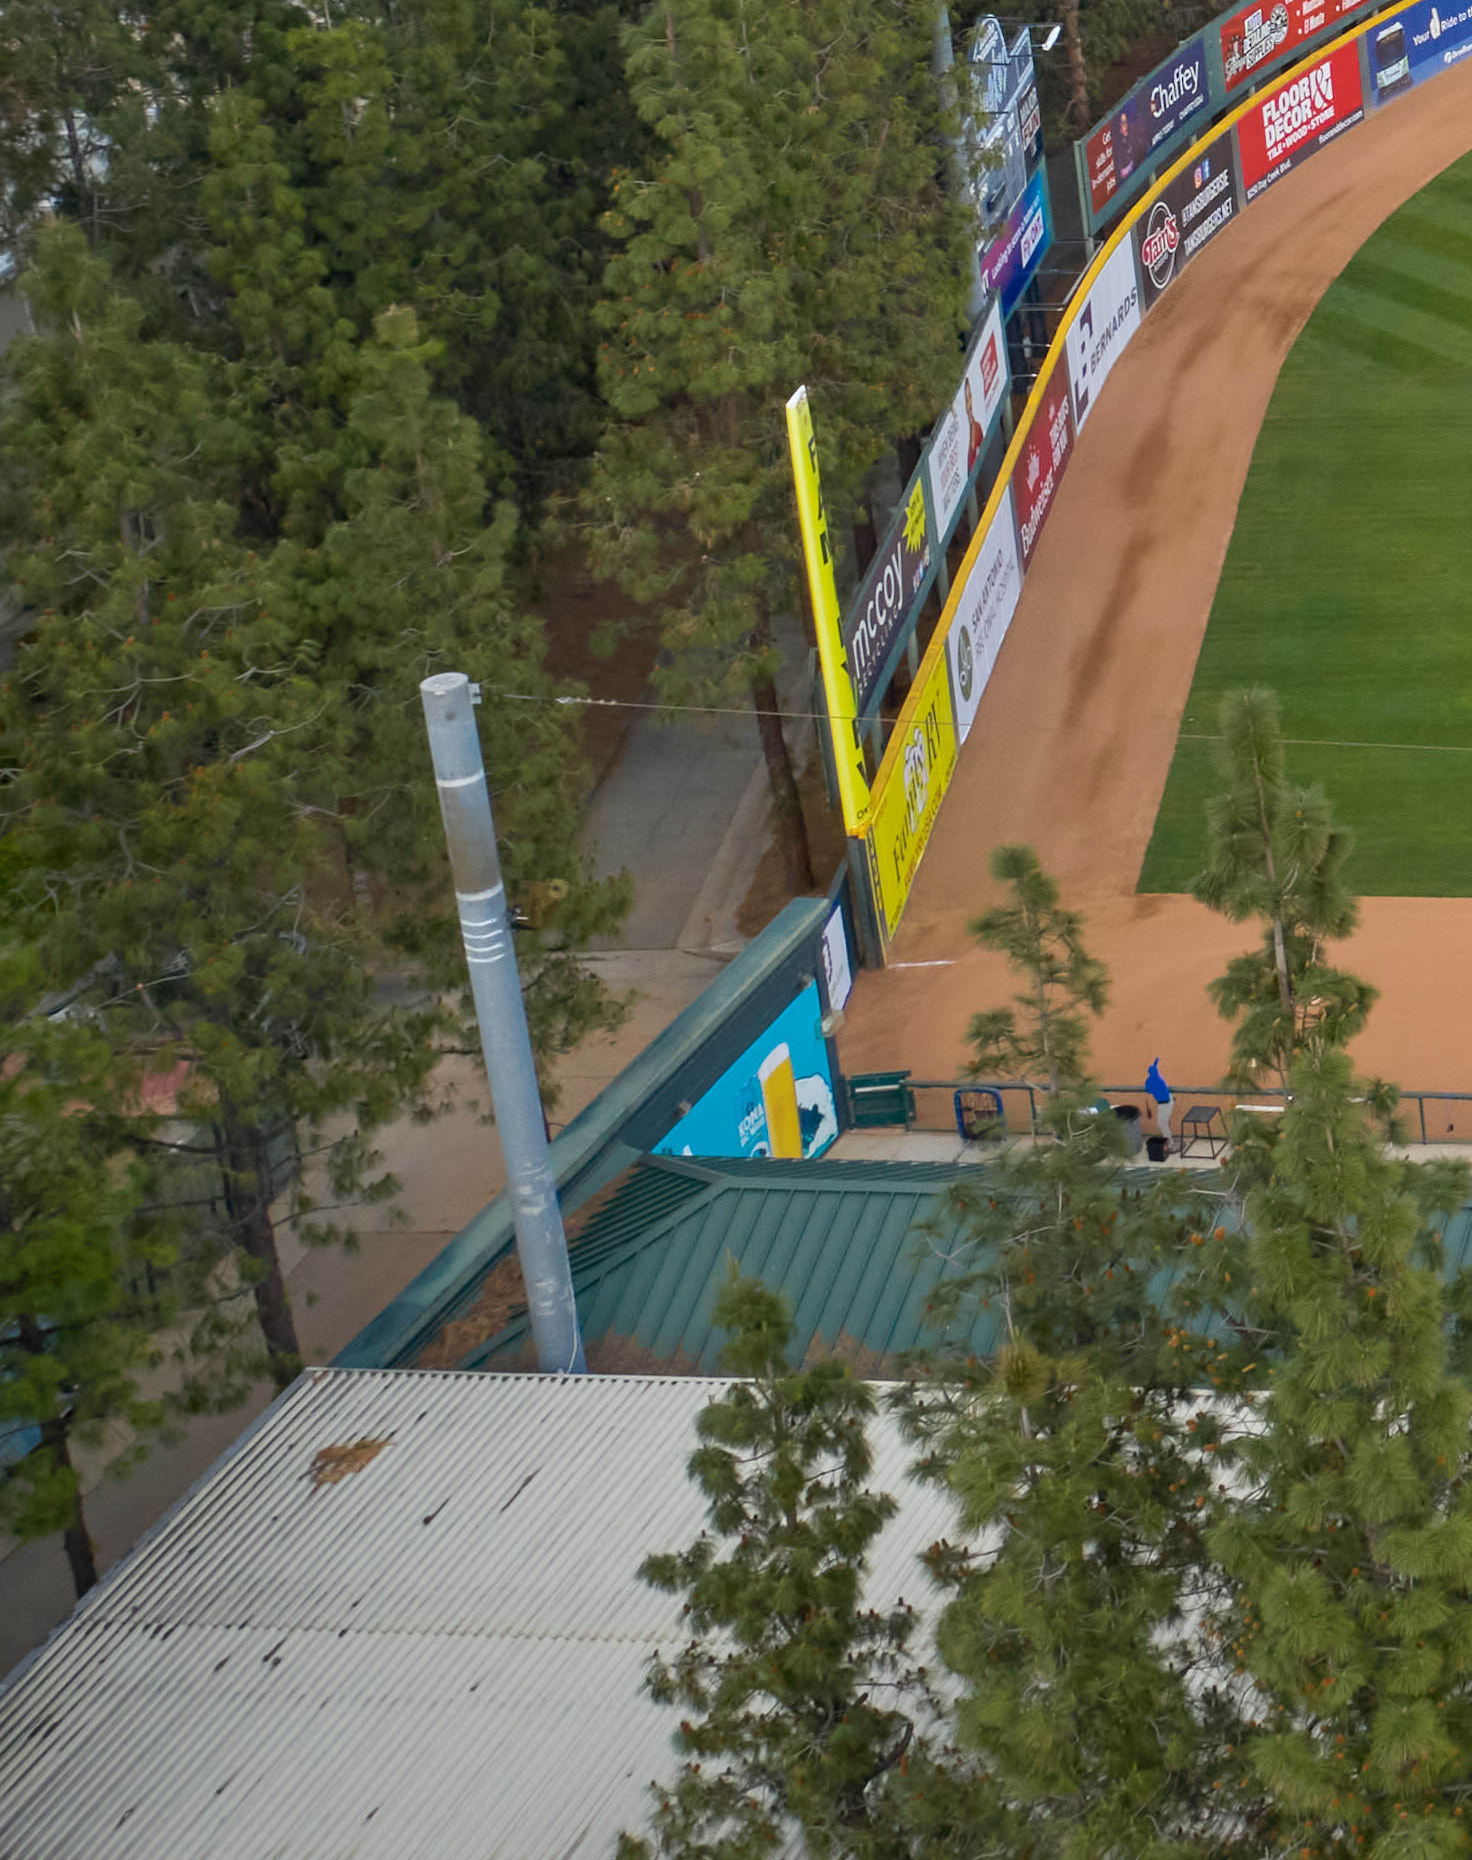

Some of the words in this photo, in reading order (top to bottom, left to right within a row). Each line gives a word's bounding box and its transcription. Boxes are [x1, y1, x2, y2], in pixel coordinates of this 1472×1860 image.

[1412, 28, 1430, 47] Your
[1440, 13, 1458, 32] Ride
[1152, 61, 1199, 118] Chaffey
[1262, 73, 1312, 127] FLOOR
[1265, 104, 1314, 149] DECOR
[1089, 287, 1137, 374] BERNARDS
[1021, 467, 1054, 558] Budweiser
[852, 543, 903, 678] mccoy
[972, 600, 984, 634] SAN
[981, 548, 1003, 609] ANTONIO
